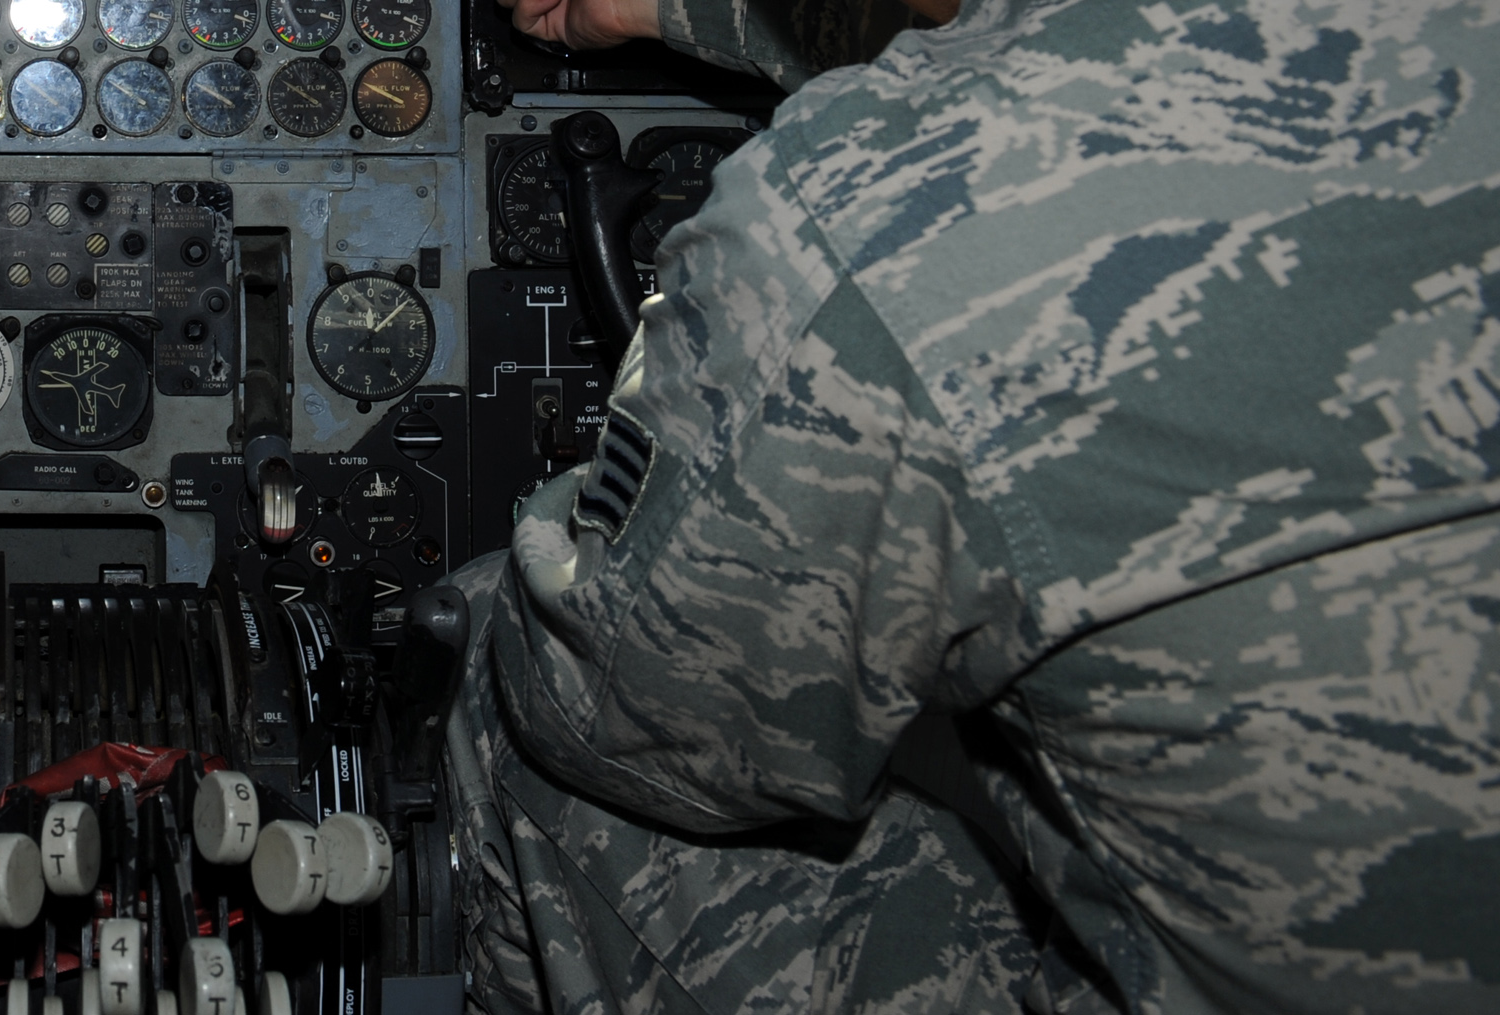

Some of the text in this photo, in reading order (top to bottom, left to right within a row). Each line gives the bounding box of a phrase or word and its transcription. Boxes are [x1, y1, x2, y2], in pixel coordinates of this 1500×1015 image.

[694, 156, 702, 168] 2
[522, 176, 536, 184] 300
[368, 289, 374, 297] 0
[527, 286, 566, 294] 1 ENG 2
[325, 317, 331, 325] 8
[68, 341, 77, 350] 10
[83, 339, 88, 347] 0
[96, 340, 105, 350] 10
[54, 348, 65, 359] 20
[107, 348, 119, 358] 20
[338, 365, 344, 373] 6
[365, 376, 371, 384] 5
[341, 750, 349, 782] LOCKED
[236, 784, 250, 800] 6
[51, 818, 65, 836] 3
[238, 823, 251, 842] T
[373, 826, 386, 844] 8
[304, 836, 316, 854] 7
[50, 855, 65, 874] T
[310, 874, 322, 893] T
[112, 938, 128, 956] 4
[110, 982, 127, 1003] T
